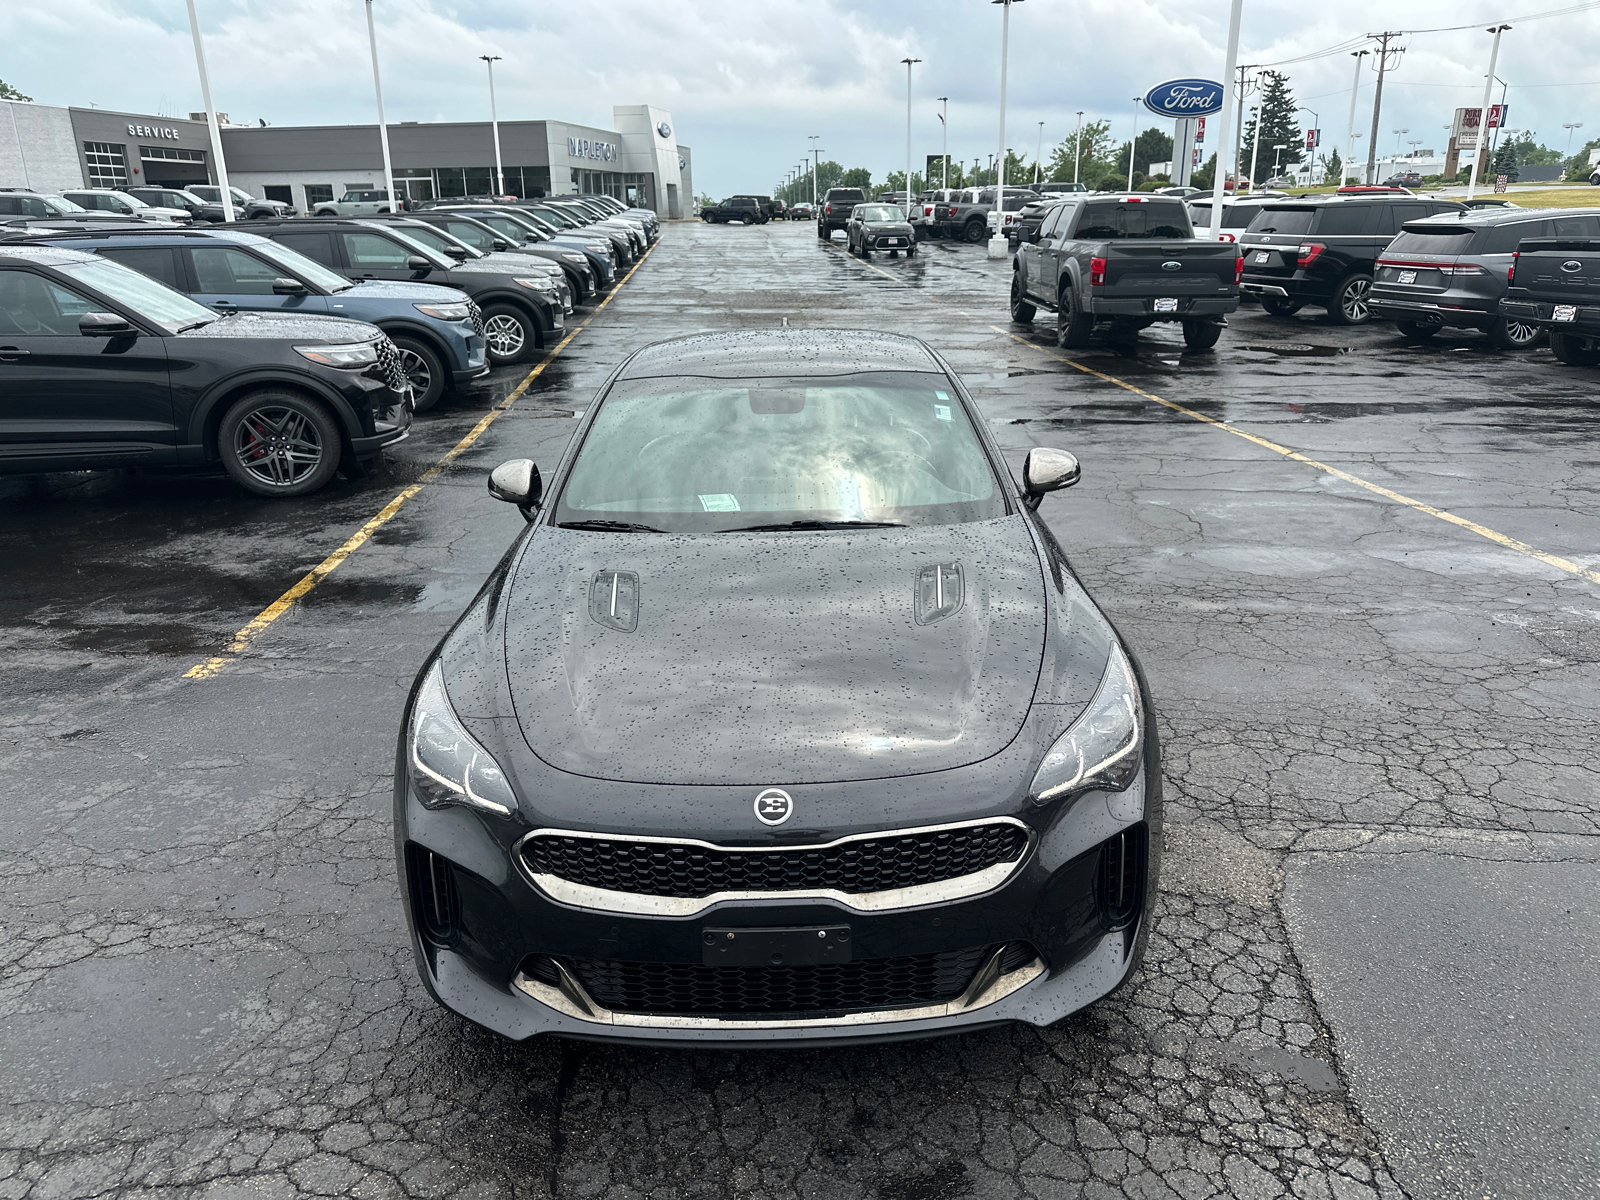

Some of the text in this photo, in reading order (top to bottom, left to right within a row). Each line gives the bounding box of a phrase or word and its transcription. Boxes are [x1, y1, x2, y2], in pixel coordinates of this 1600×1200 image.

[1164, 86, 1216, 109] Ford
[128, 124, 179, 140] SERVICE
[568, 137, 617, 162] NAPLETON
